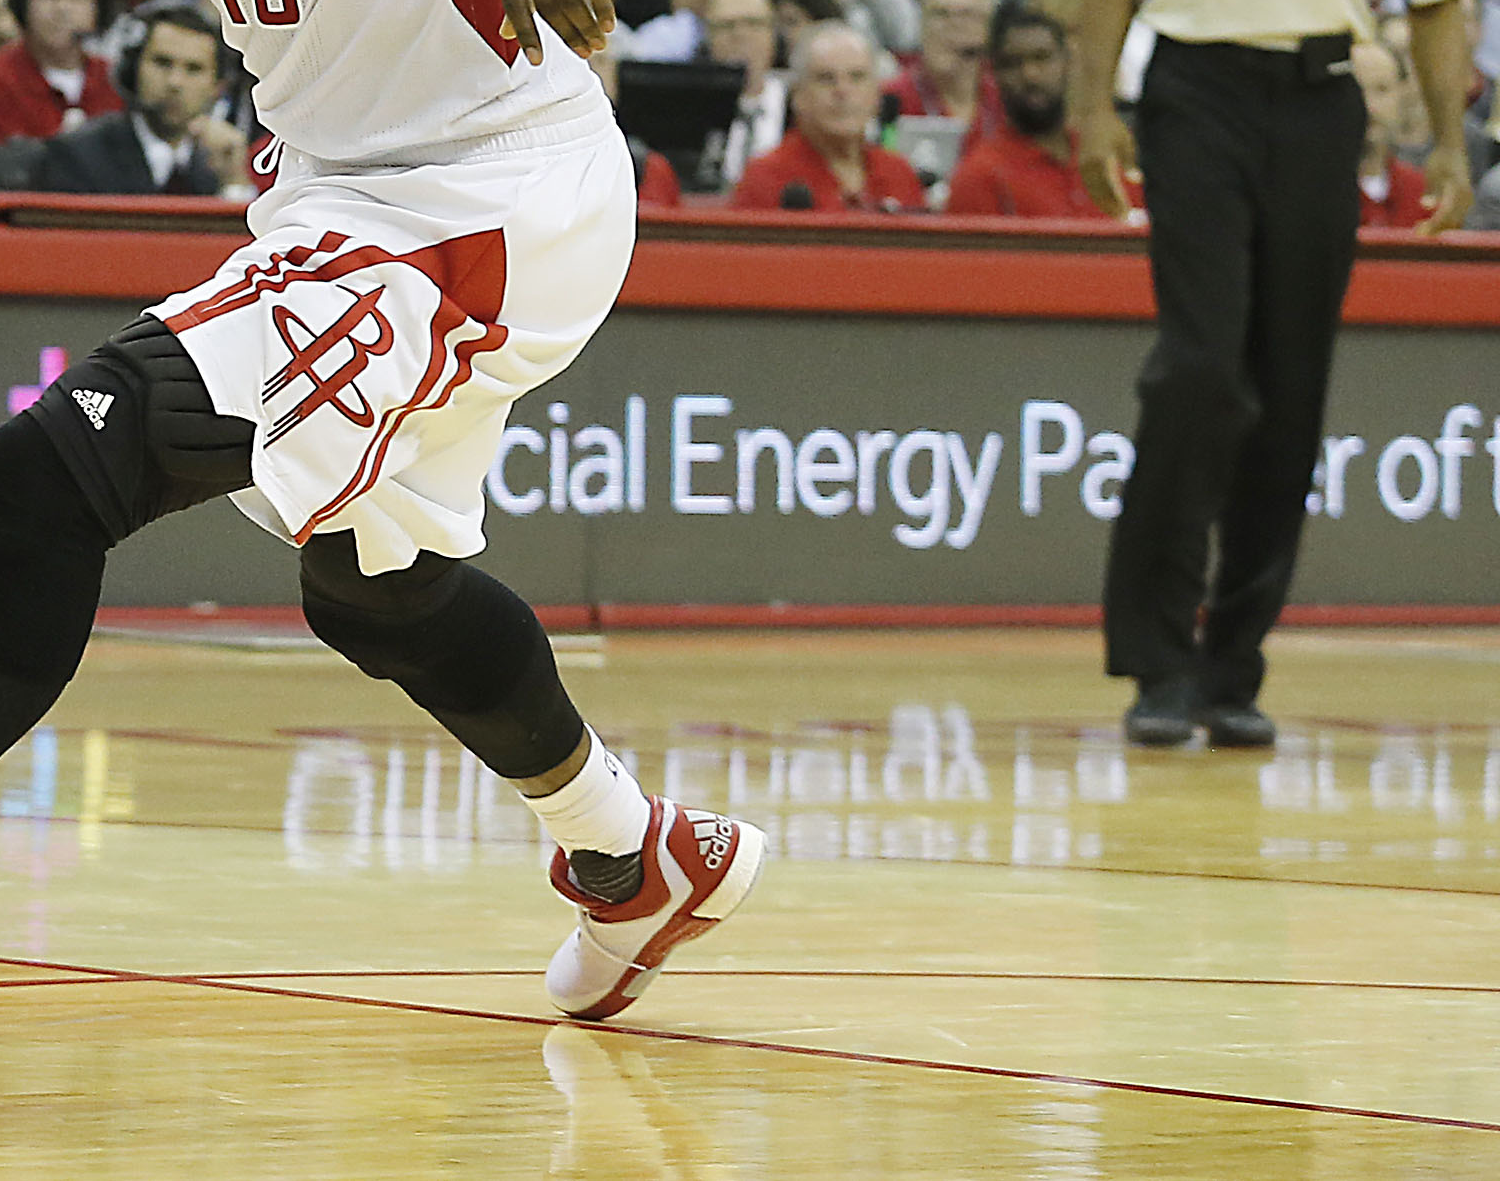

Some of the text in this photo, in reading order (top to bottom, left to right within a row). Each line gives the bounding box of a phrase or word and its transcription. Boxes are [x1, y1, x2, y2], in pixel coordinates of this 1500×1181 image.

[71, 389, 105, 430] adidas
[484, 393, 647, 516] cial
[671, 394, 1002, 550] Energy
[1376, 403, 1484, 521] of
